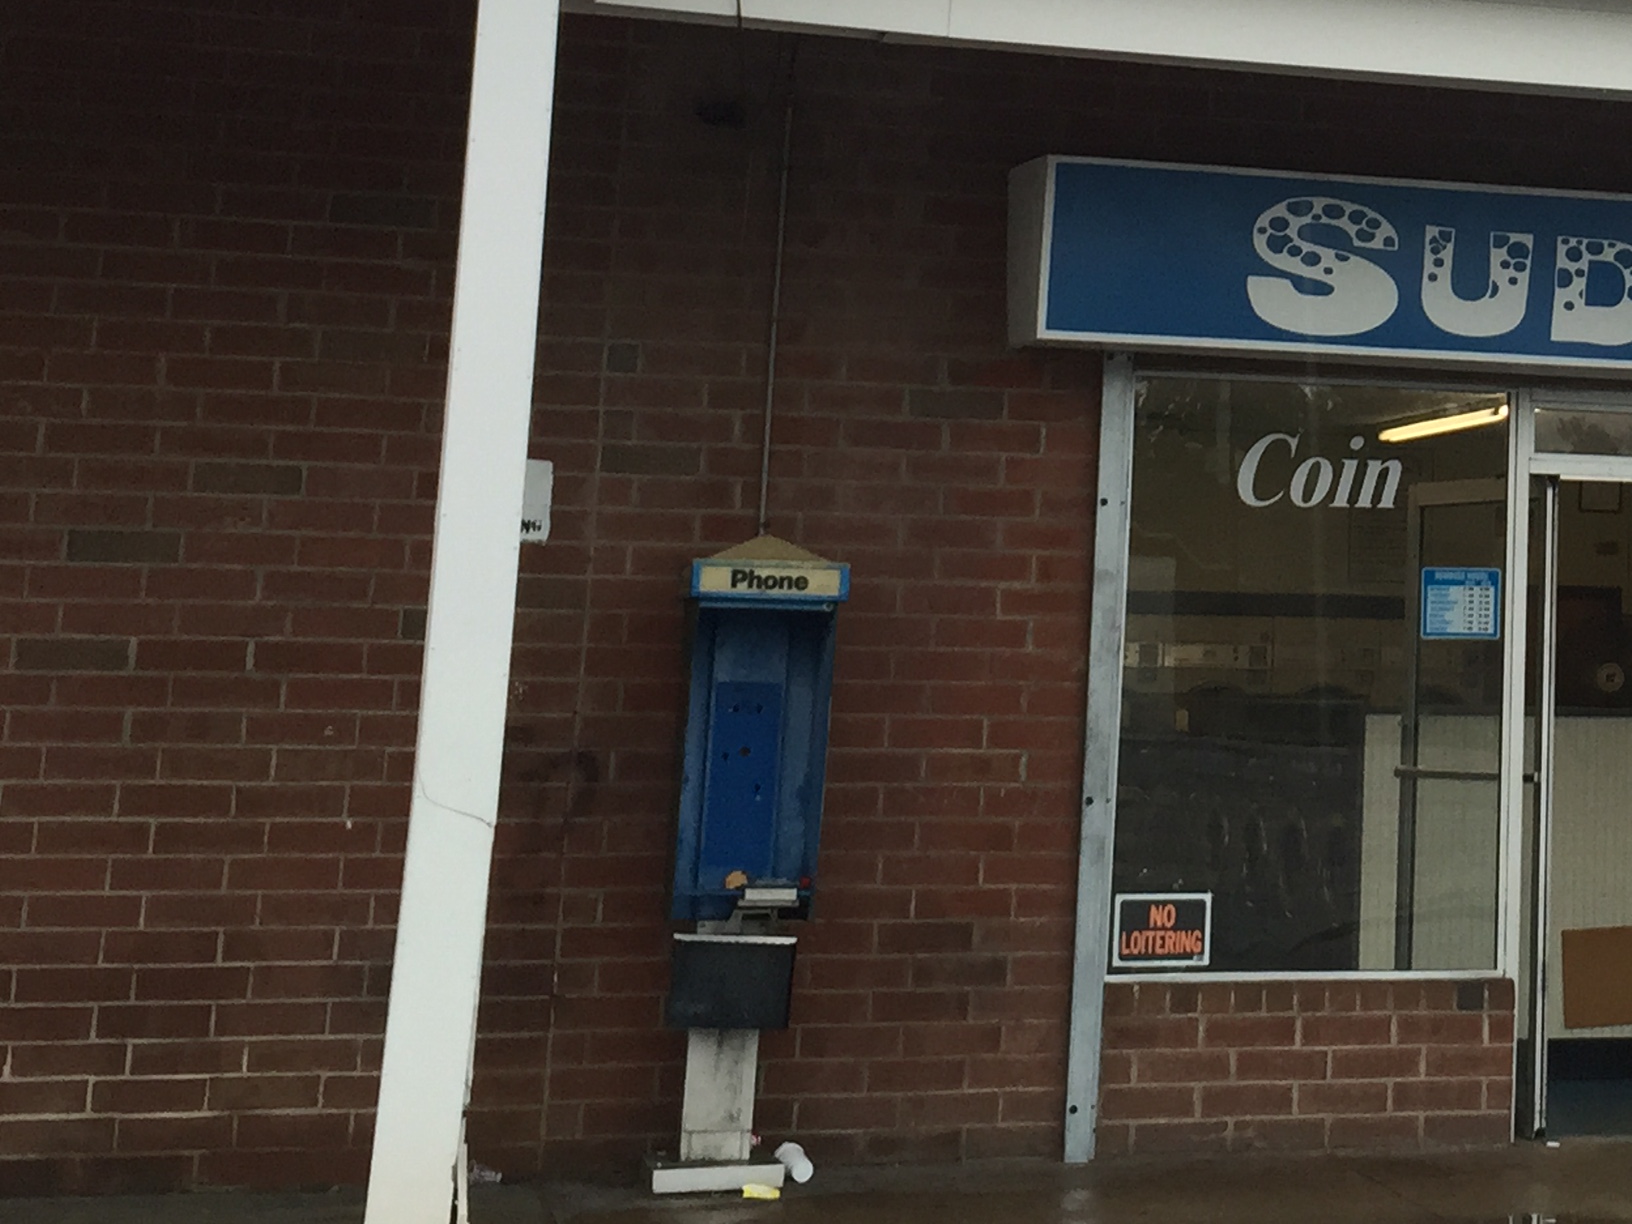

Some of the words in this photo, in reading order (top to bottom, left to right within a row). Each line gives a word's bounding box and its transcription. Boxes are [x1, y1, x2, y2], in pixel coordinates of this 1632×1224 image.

[1236, 432, 1403, 509] Coin
[730, 569, 809, 591] Phone
[1148, 903, 1176, 928] NO
[1120, 929, 1202, 955] LOITERING
